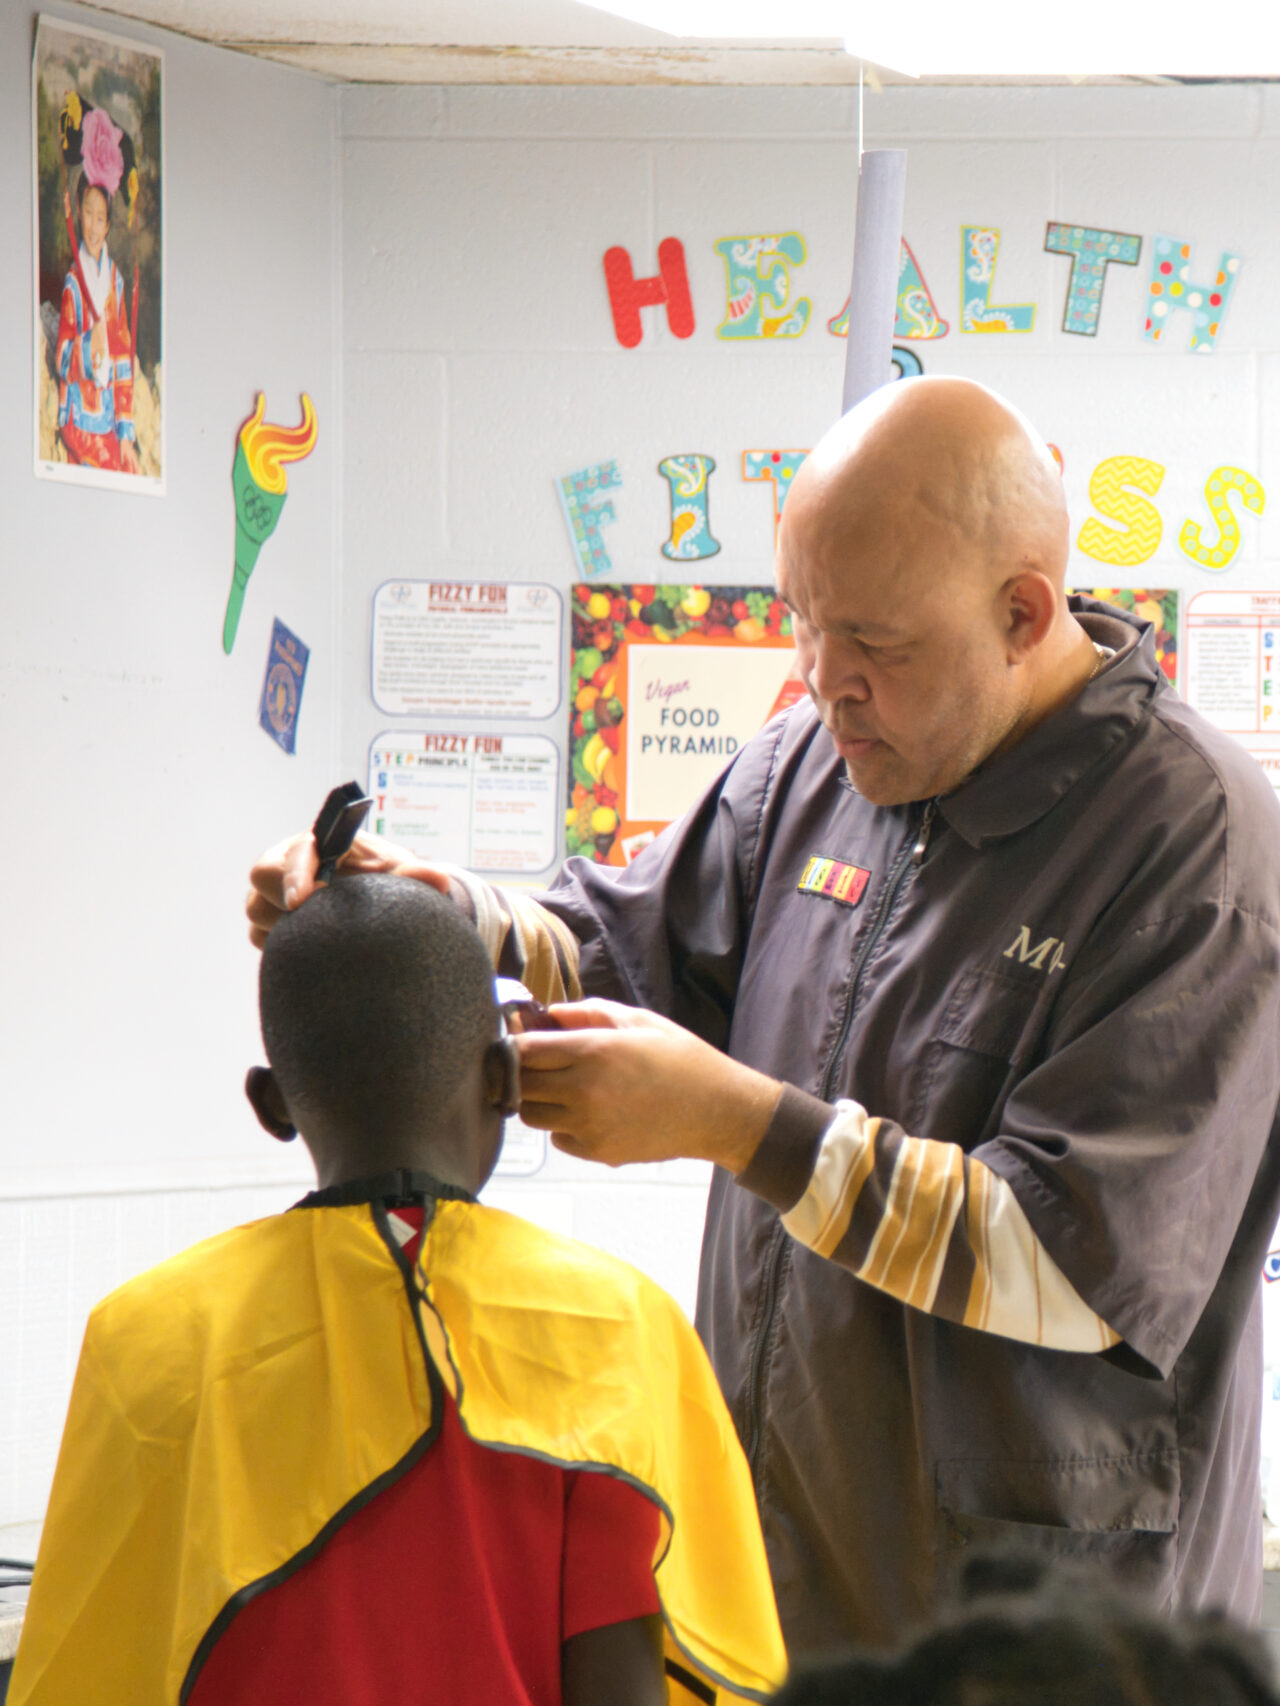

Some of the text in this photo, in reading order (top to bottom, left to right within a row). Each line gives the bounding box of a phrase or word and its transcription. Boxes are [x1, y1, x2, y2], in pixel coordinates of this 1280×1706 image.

[429, 583, 507, 602] FIZZY FUN
[1264, 656, 1273, 672] T
[645, 678, 691, 701] Vegan
[1263, 680, 1272, 696] E
[660, 708, 720, 727] FOOD
[1263, 705, 1273, 722] P
[425, 735, 503, 753] FIZZY FUN
[641, 735, 738, 755] PYRAMID
[377, 772, 387, 788] S
[377, 795, 386, 811] T
[376, 818, 385, 835] E
